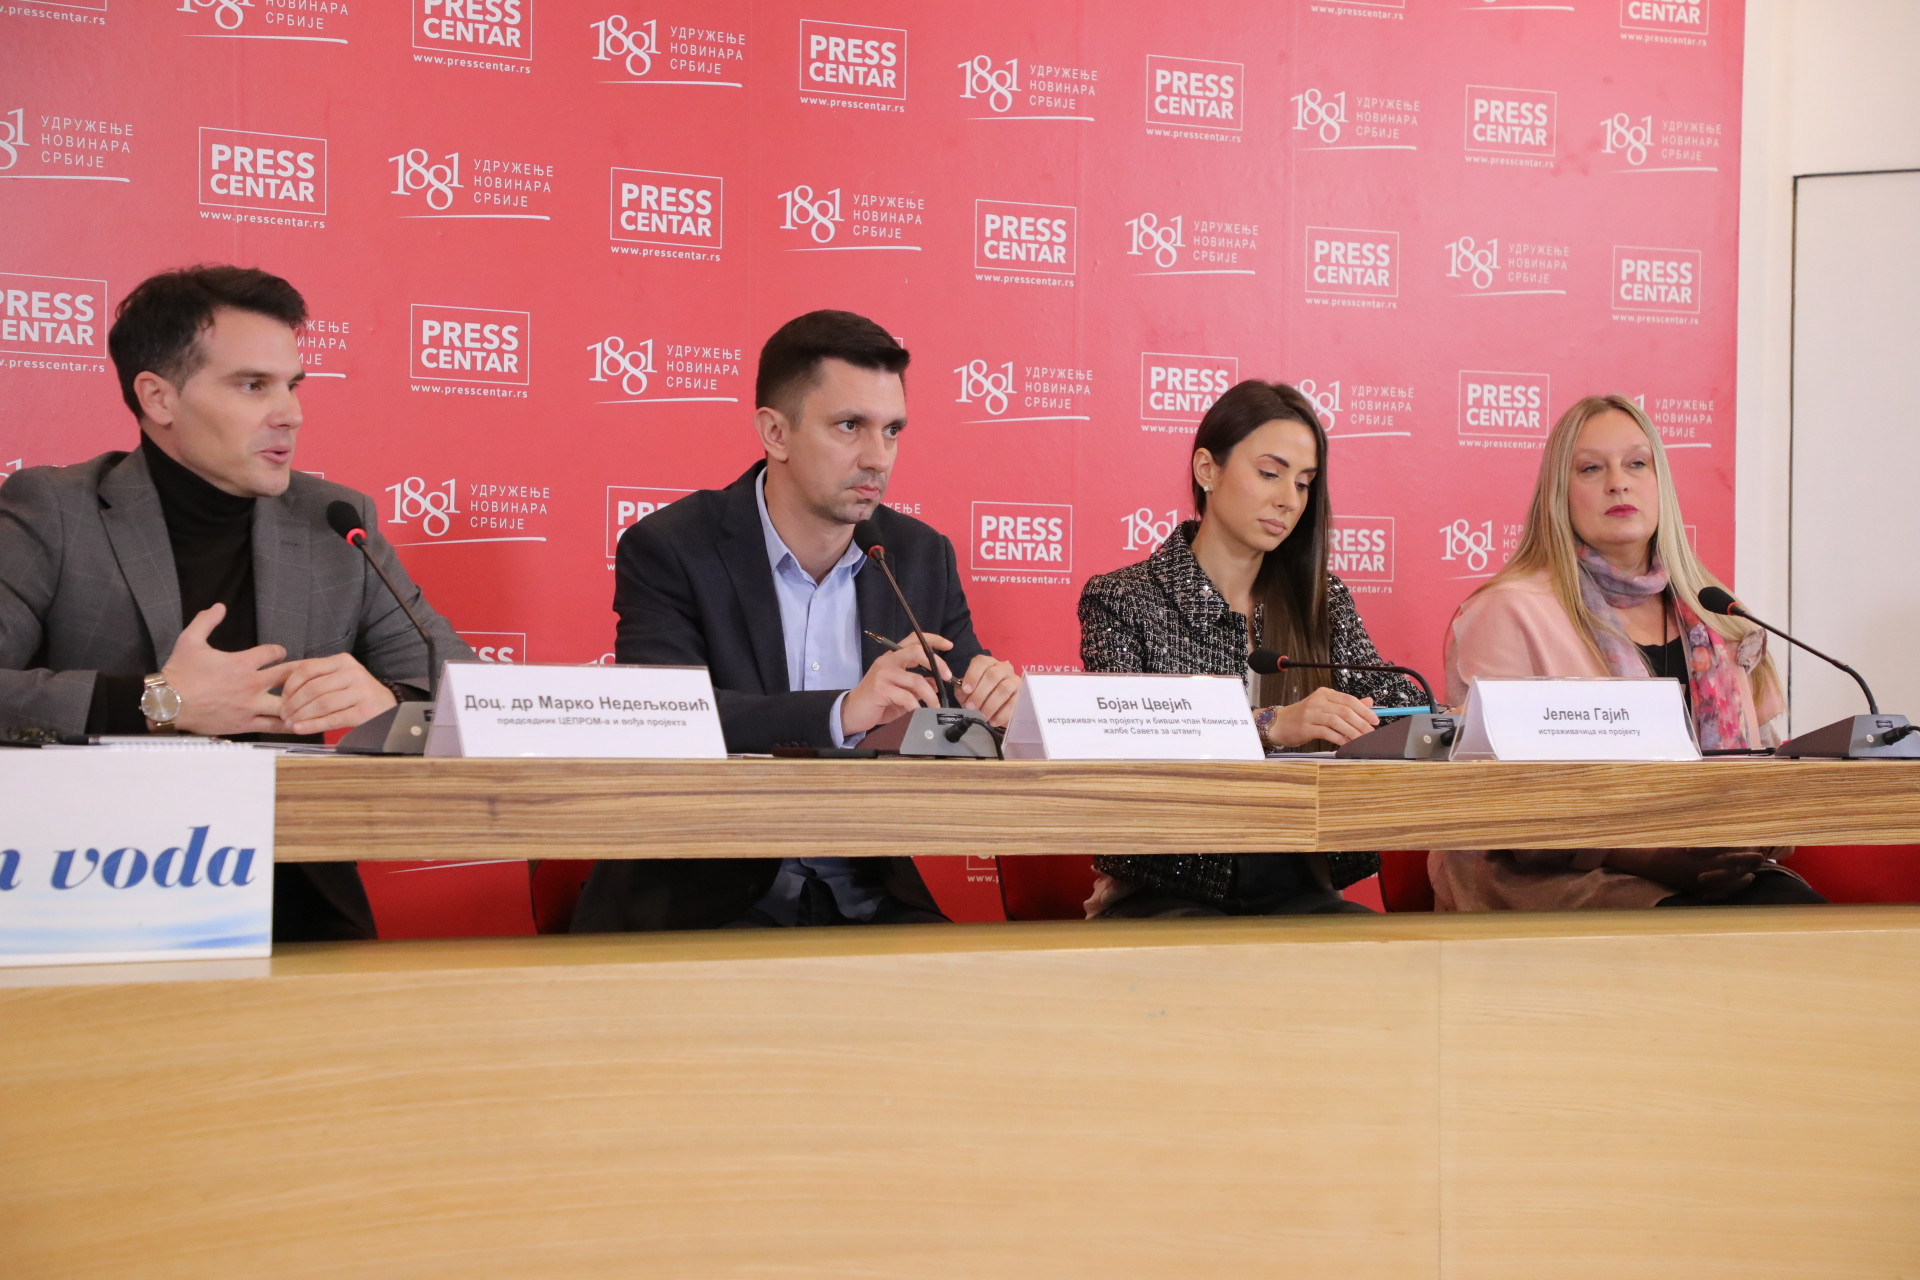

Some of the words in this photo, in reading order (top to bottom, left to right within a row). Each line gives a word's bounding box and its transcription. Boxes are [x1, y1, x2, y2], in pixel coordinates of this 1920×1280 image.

[266, 12, 323, 29] СРБИЈЕ
[424, 0, 521, 24] PRESS
[1311, 6, 1403, 20] www.presscentar.rs
[1628, 0, 1700, 24] CENTAR
[423, 18, 521, 47] CENTAR
[671, 26, 745, 45] УДРУЖЕЊЕ
[1621, 33, 1706, 46] www.presscentar.rs
[590, 15, 661, 76] 1881
[670, 43, 742, 60] НОВИНАРА
[809, 35, 896, 67] PRESS
[413, 52, 532, 73] www.presscentar.rs
[670, 59, 721, 74] СРБИЈЕ
[809, 61, 896, 88] CENTAR
[1030, 65, 1097, 81] УДРУЖЕЊЕ
[958, 55, 1021, 112] 1881
[1030, 80, 1095, 96] НОВИНАРА
[1155, 69, 1234, 99] PRESS
[800, 95, 906, 112] www.presscentar.rs
[1030, 95, 1075, 109] СРБИЈЕ
[1155, 95, 1234, 119] CENTAR
[1357, 97, 1419, 111] УДРУЖЕЊЕ
[1291, 89, 1349, 143] 1881
[1356, 112, 1417, 125] НОВИНАРА
[1473, 99, 1547, 126] PRESS
[42, 116, 133, 136] УДРУЖЕЊЕ
[1356, 126, 1399, 139] СРБИЈЕ
[1473, 123, 1546, 145] CENTAR
[1663, 120, 1721, 134] УДРУЖЕЊЕ
[42, 134, 129, 153] НОВИНАРА
[1146, 129, 1241, 142] www.presscentar.rs
[1600, 113, 1654, 165] 1881
[1662, 135, 1719, 147] НОВИНАРА
[42, 151, 103, 168] СРБИЈЕ
[211, 144, 314, 179] PRESS
[1465, 156, 1553, 168] www.presscentar.rs
[1662, 148, 1701, 161] СРБИЈЕ
[474, 159, 553, 177] УДРУЖЕЊЕ
[389, 148, 464, 210] 1881
[474, 176, 550, 193] НОВИНАРА
[211, 174, 314, 202] CENTAR
[474, 192, 527, 207] СРБИЈЕ
[621, 183, 712, 214] PRESS
[854, 194, 924, 209] УДРУЖЕЊЕ
[200, 210, 326, 228] www.presscentar.rs
[778, 185, 844, 243] 1881
[854, 210, 922, 224] НОВИНАРА
[621, 210, 712, 236] CENTAR
[853, 225, 901, 238] СРБИЈЕ
[984, 214, 1066, 243] PRESS
[1194, 221, 1258, 235] УДРУЖЕЊЕ
[1125, 213, 1186, 267] 1881
[1194, 236, 1256, 250] НОВИНАРА
[611, 246, 720, 261] www.presscentar.rs
[984, 240, 1066, 263] CENTAR
[1193, 250, 1237, 263] СРБИЈЕ
[1314, 240, 1390, 267] PRESS
[1509, 244, 1569, 257] УДРУЖЕЊЕ
[1445, 236, 1501, 289] 1881
[1508, 258, 1567, 270] НОВИНАРА
[1314, 265, 1389, 286] CENTAR
[1508, 272, 1549, 284] СРБИЈЕ
[1622, 259, 1692, 284] PRESS
[976, 274, 1074, 287] www.presscentar.rs
[1620, 283, 1691, 303] CENTAR
[1306, 298, 1396, 308] www.presscentar.rs
[1612, 314, 1698, 324] www.presscentar.rs
[0, 319, 94, 345] ENTAR
[422, 320, 518, 351] PRESS
[421, 347, 518, 373] CENTAR
[667, 345, 741, 360] УДРУЖЕЊЕ
[587, 336, 657, 395] 1881
[667, 361, 738, 375] НОВИНАРА
[1026, 367, 1092, 380] УДРУЖЕЊЕ
[667, 376, 717, 390] СРБИЈЕ
[954, 360, 1017, 415] 1881
[1026, 382, 1090, 395] НОВИНАРА
[1151, 367, 1228, 393] PRESS
[411, 385, 527, 398] www.presscentar.rs
[1352, 386, 1414, 398] УДРУЖЕЊЕ
[1468, 384, 1540, 408] PRESS
[1025, 397, 1071, 409] СРБИЈЕ
[1150, 392, 1218, 412] CENTA
[1293, 379, 1343, 432] 881
[1351, 400, 1411, 412] НОВИНАРА
[1656, 399, 1713, 410] УДРУЖЕЊЕ
[1351, 414, 1393, 425] СРБИЈЕ
[1467, 408, 1540, 427] CENTAR
[1655, 412, 1712, 424] НОВИНАРА
[471, 484, 549, 498] УДРУЖЕЊЕ
[385, 477, 460, 536] 1881
[471, 501, 547, 514] НОВИНАРА
[471, 517, 524, 529] СРБИЈЕ
[982, 516, 1062, 541] PRESS
[980, 541, 1062, 561] CENTAR
[1440, 519, 1495, 571] 1881
[972, 576, 1070, 584] www.presscentar.rs
[464, 694, 506, 712] Доц.
[511, 697, 533, 714] др
[538, 695, 594, 713] Марко
[598, 697, 710, 712] Недељковић
[1096, 697, 1139, 713] Бојан
[1142, 697, 1192, 713] Цвејић
[497, 717, 556, 727] председник
[558, 717, 610, 727] ЦЕПРОМ-а
[622, 718, 645, 727] вођа
[647, 719, 687, 728] пројекта
[1047, 717, 1096, 725] истраживач
[1110, 716, 1144, 726] пројекту
[1152, 717, 1180, 725] бивши
[1202, 717, 1238, 726] Комисије
[1543, 707, 1590, 720] Јелена
[1594, 707, 1630, 724] Гајић
[1103, 726, 1129, 735] жалбе
[1130, 726, 1158, 735] Савета
[1171, 728, 1202, 737] штампу
[1538, 727, 1597, 736] истраживачица
[1608, 728, 1641, 736] пројекту
[50, 825, 256, 890] voda
